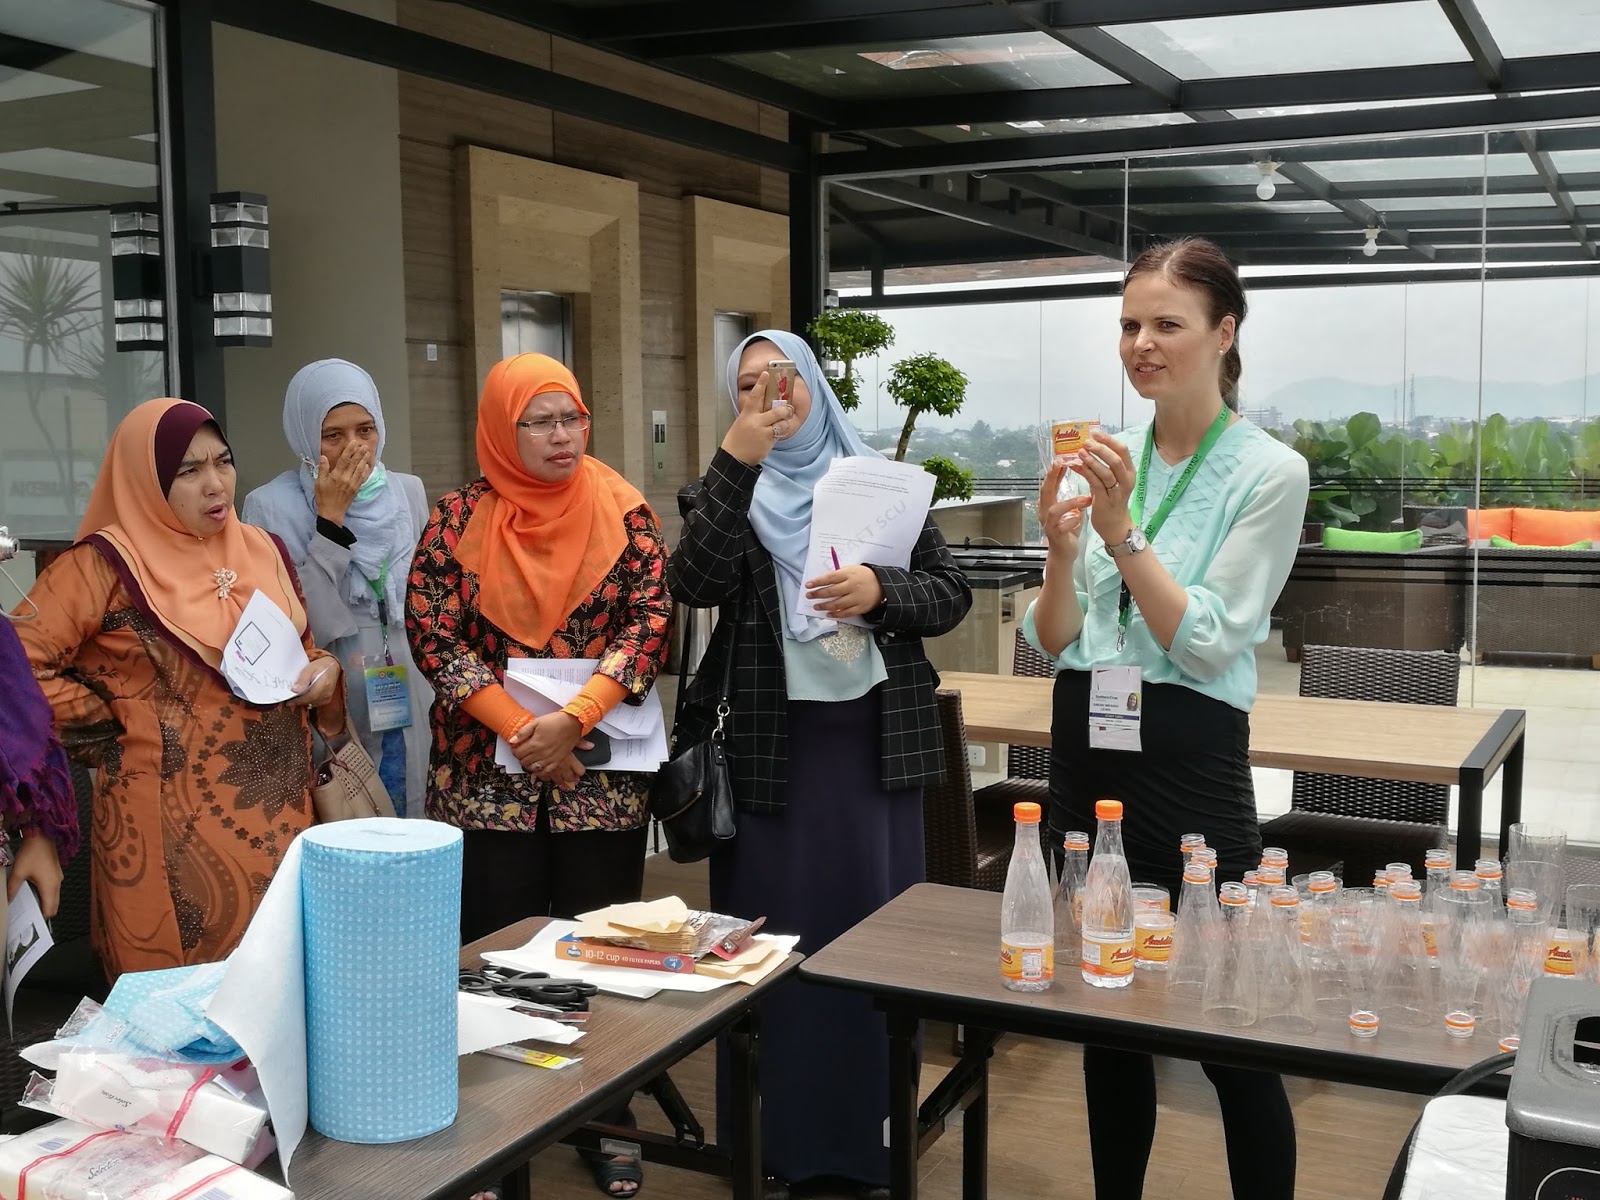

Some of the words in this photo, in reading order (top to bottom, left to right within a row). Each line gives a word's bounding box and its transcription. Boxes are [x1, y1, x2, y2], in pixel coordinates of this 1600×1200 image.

[875, 499, 907, 529] SCU
[585, 949, 604, 960] 10-12
[605, 953, 620, 964] cup
